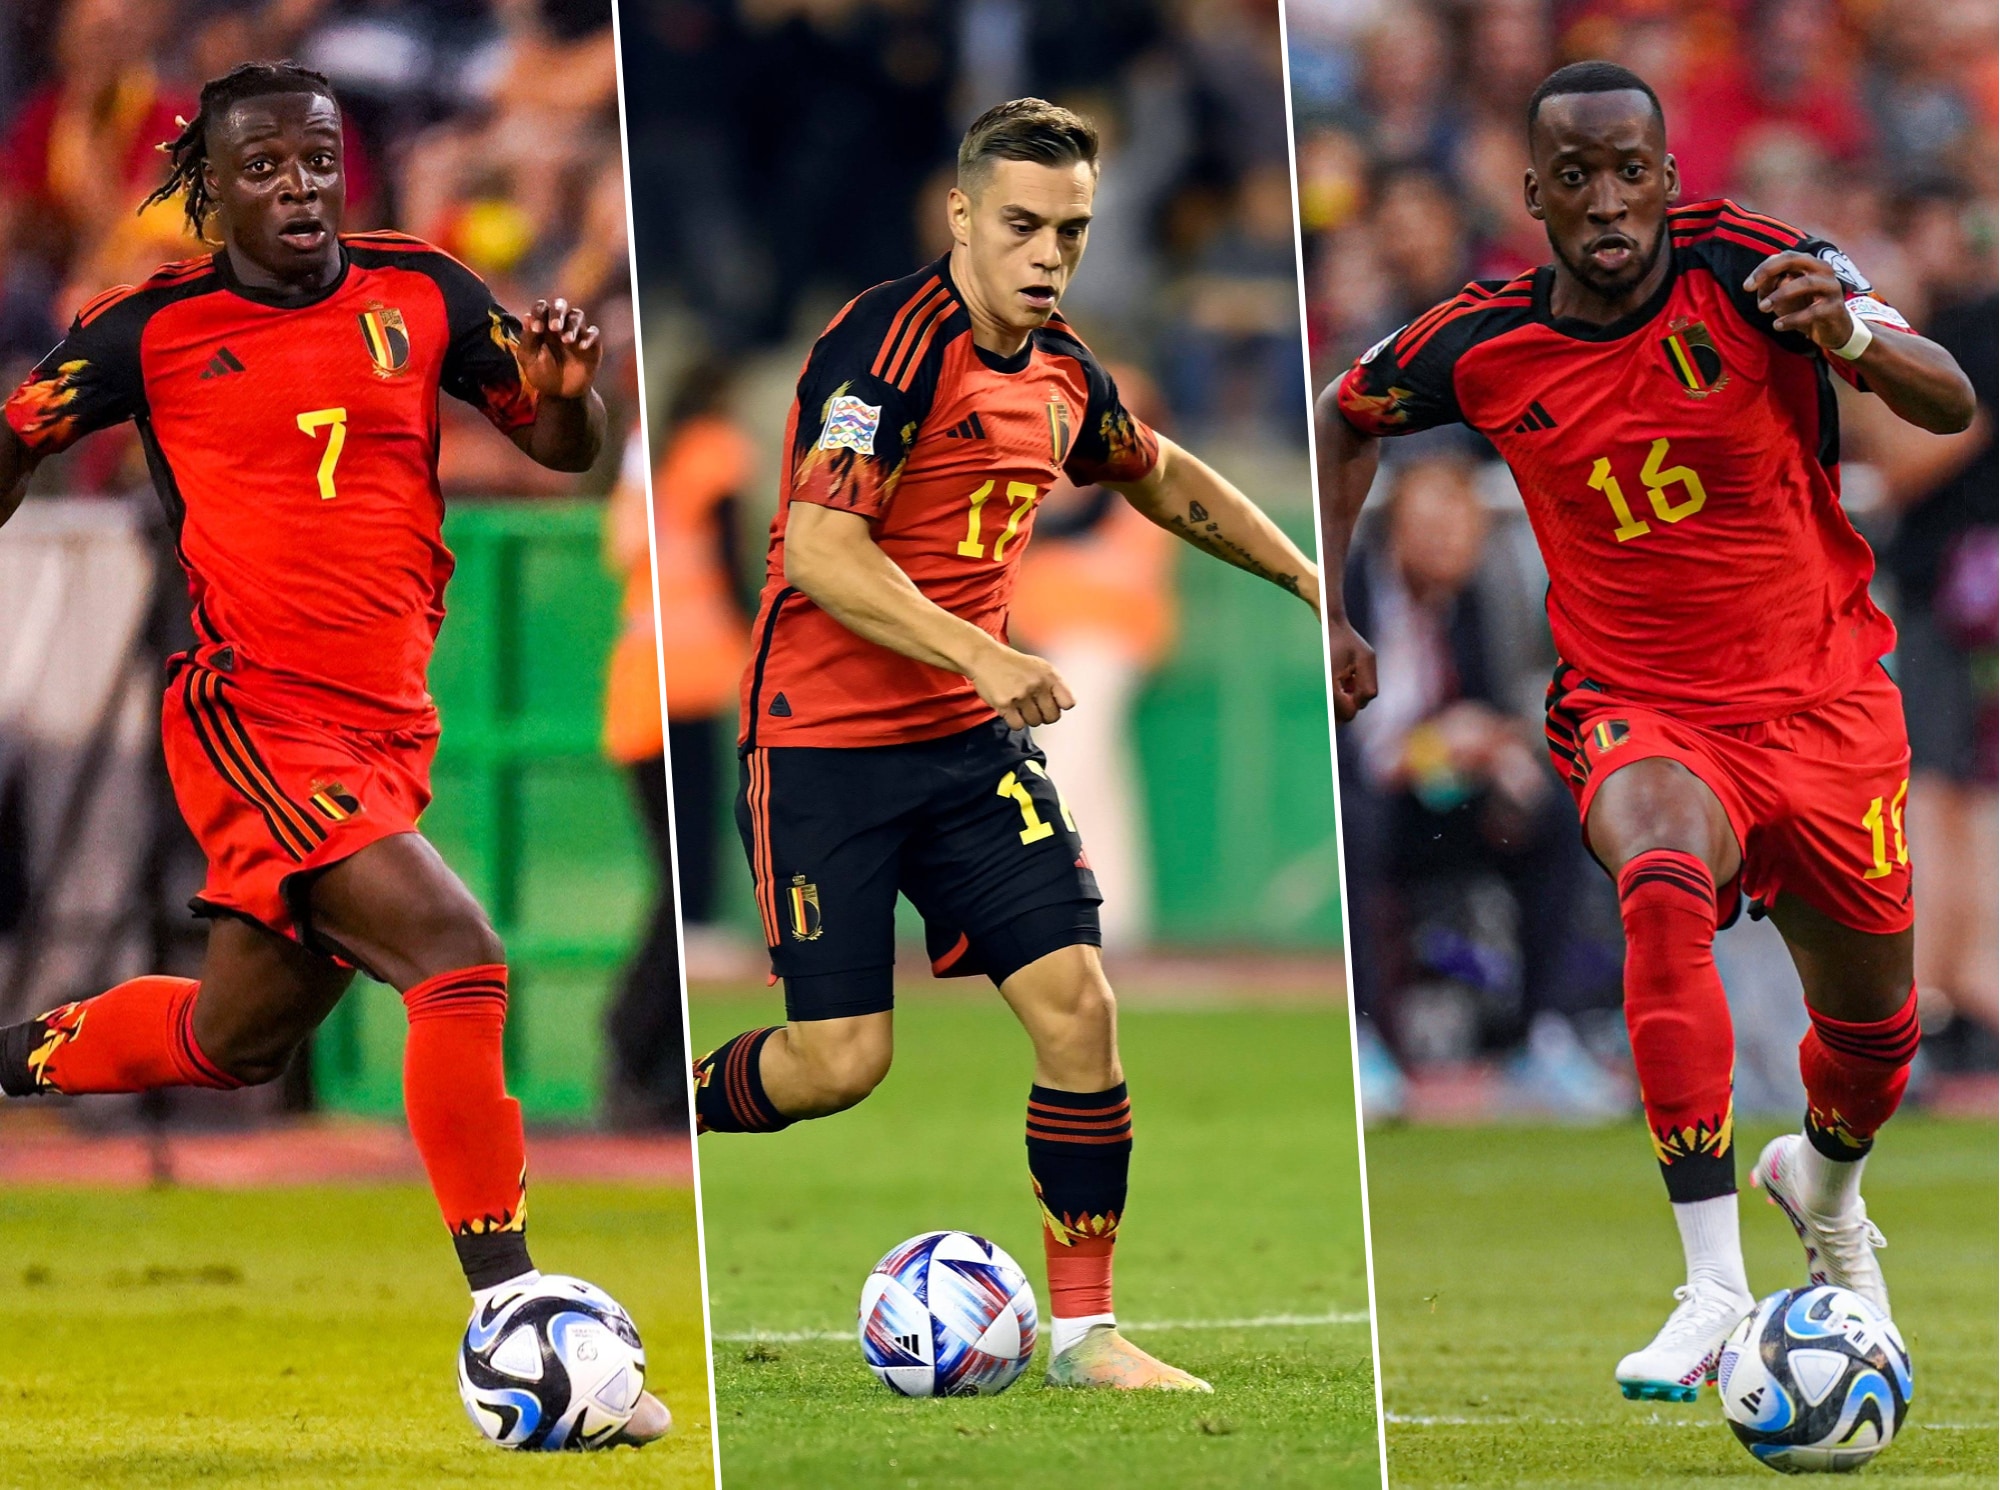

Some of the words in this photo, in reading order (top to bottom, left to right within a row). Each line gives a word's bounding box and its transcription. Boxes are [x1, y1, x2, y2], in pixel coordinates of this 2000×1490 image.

[296, 407, 347, 500] 7
[1587, 437, 1707, 542] 16
[957, 479, 1037, 562] 17
